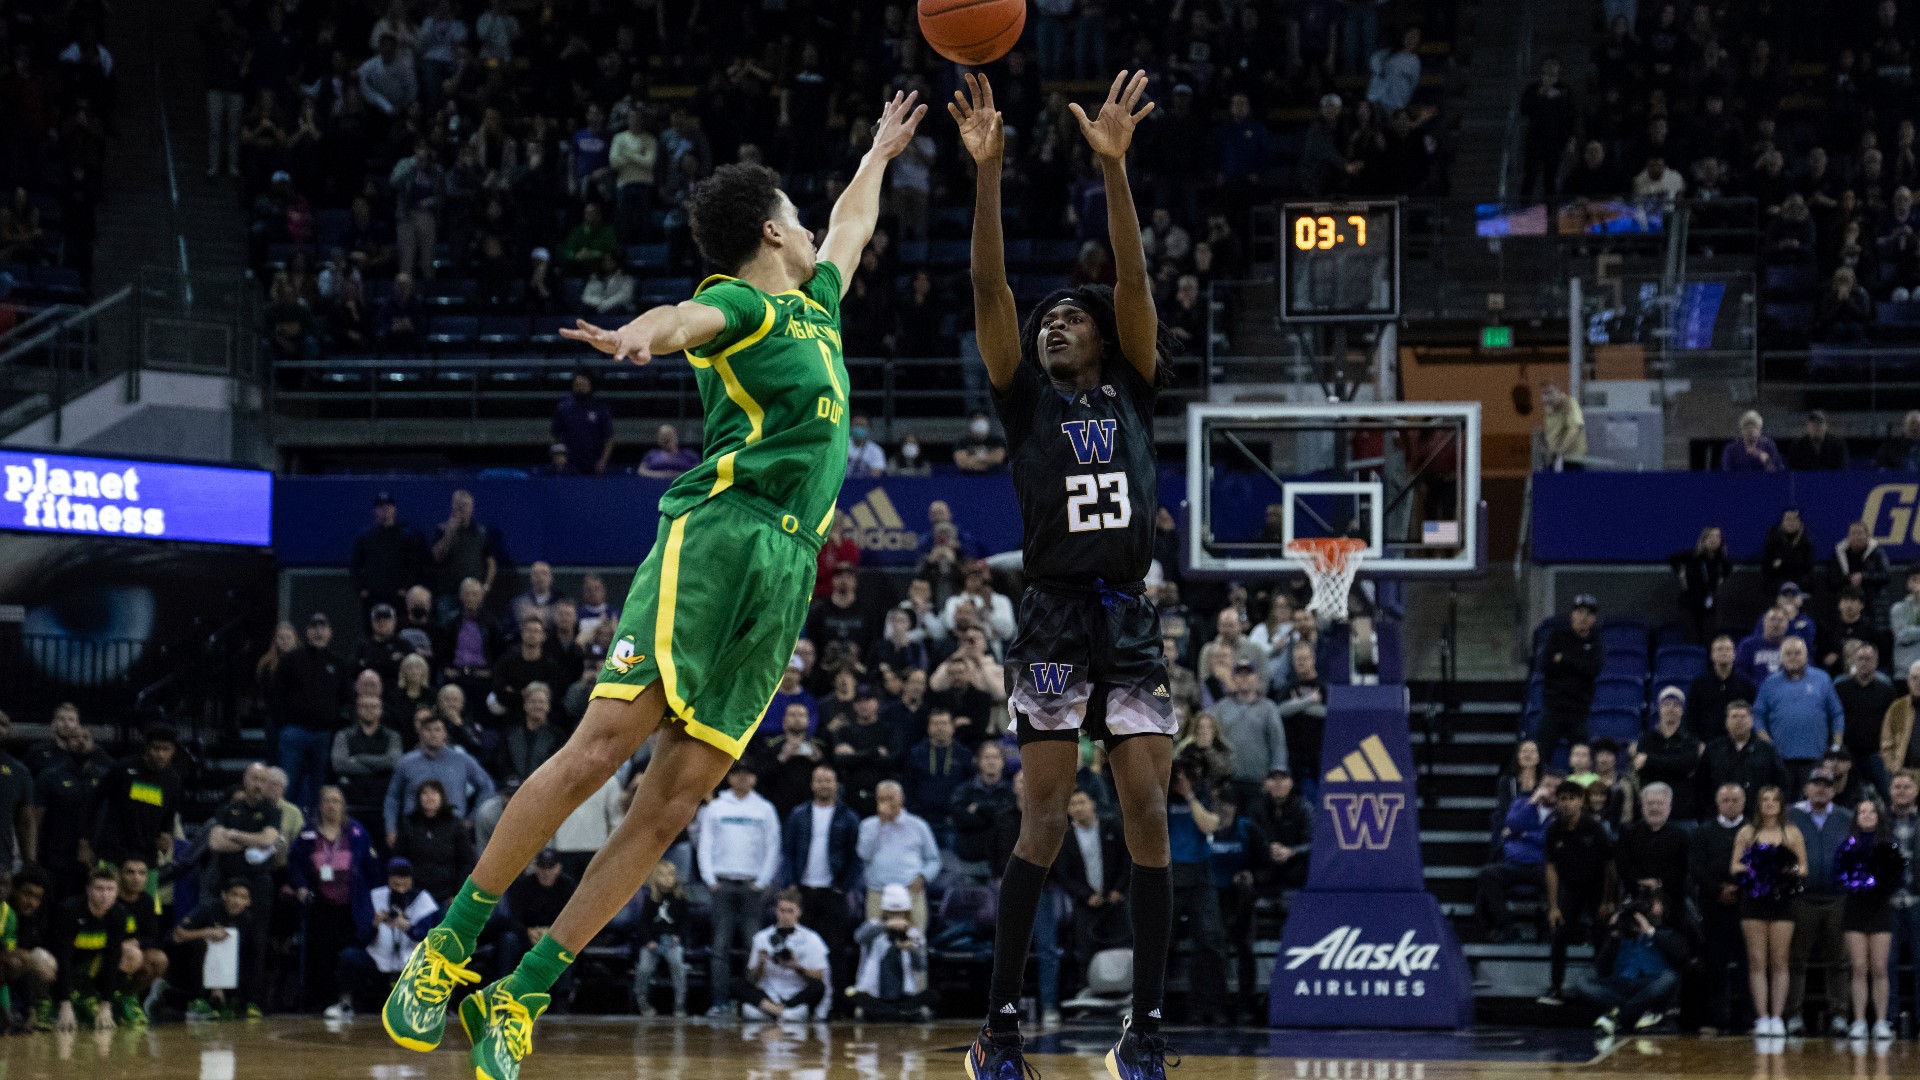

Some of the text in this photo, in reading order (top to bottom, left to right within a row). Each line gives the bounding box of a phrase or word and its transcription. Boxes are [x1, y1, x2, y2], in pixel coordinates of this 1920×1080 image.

[1295, 216, 1366, 250] 03.7
[1061, 419, 1117, 464] W
[4, 458, 140, 502] planet
[1065, 471, 1132, 532] 23
[23, 491, 165, 535] fitness
[1861, 483, 1920, 545] G
[1029, 662, 1073, 695] W
[1323, 793, 1405, 850] W
[1284, 925, 1441, 977] Alaska
[1293, 979, 1426, 997] AIRLINES
